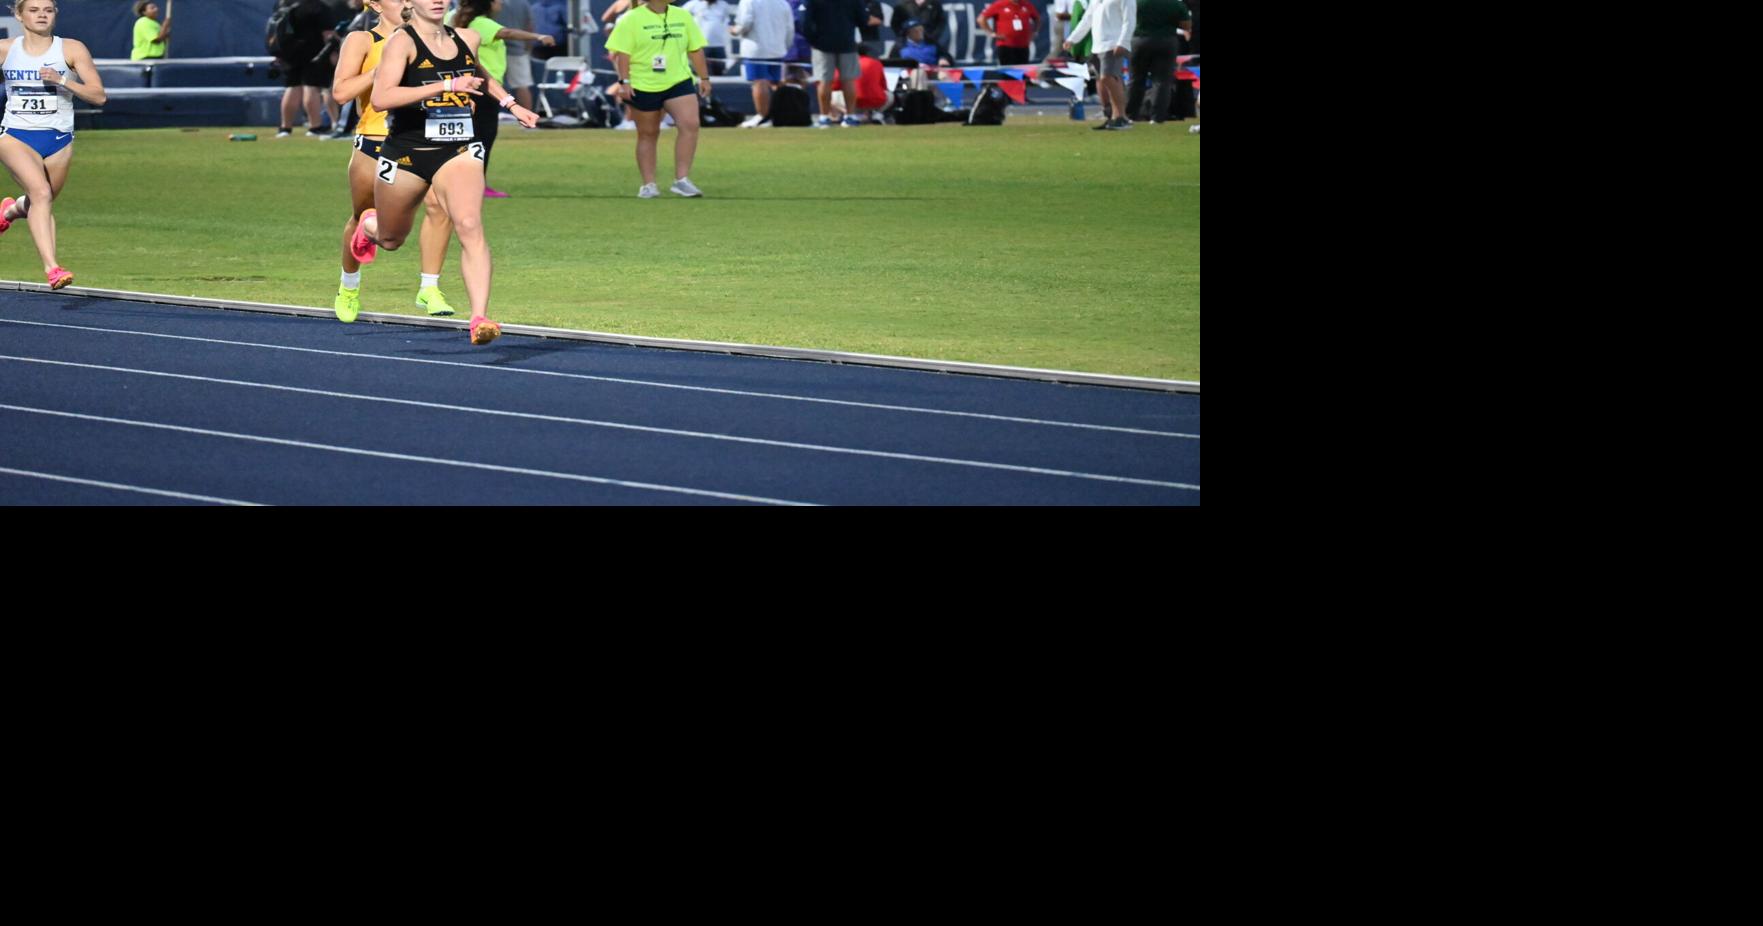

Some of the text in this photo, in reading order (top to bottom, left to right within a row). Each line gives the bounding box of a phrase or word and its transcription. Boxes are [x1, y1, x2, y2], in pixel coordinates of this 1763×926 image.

[4, 70, 66, 81] KENTUY
[21, 99, 46, 109] 731
[439, 122, 464, 135] 693
[470, 144, 483, 160] 2
[379, 161, 393, 181] 2
